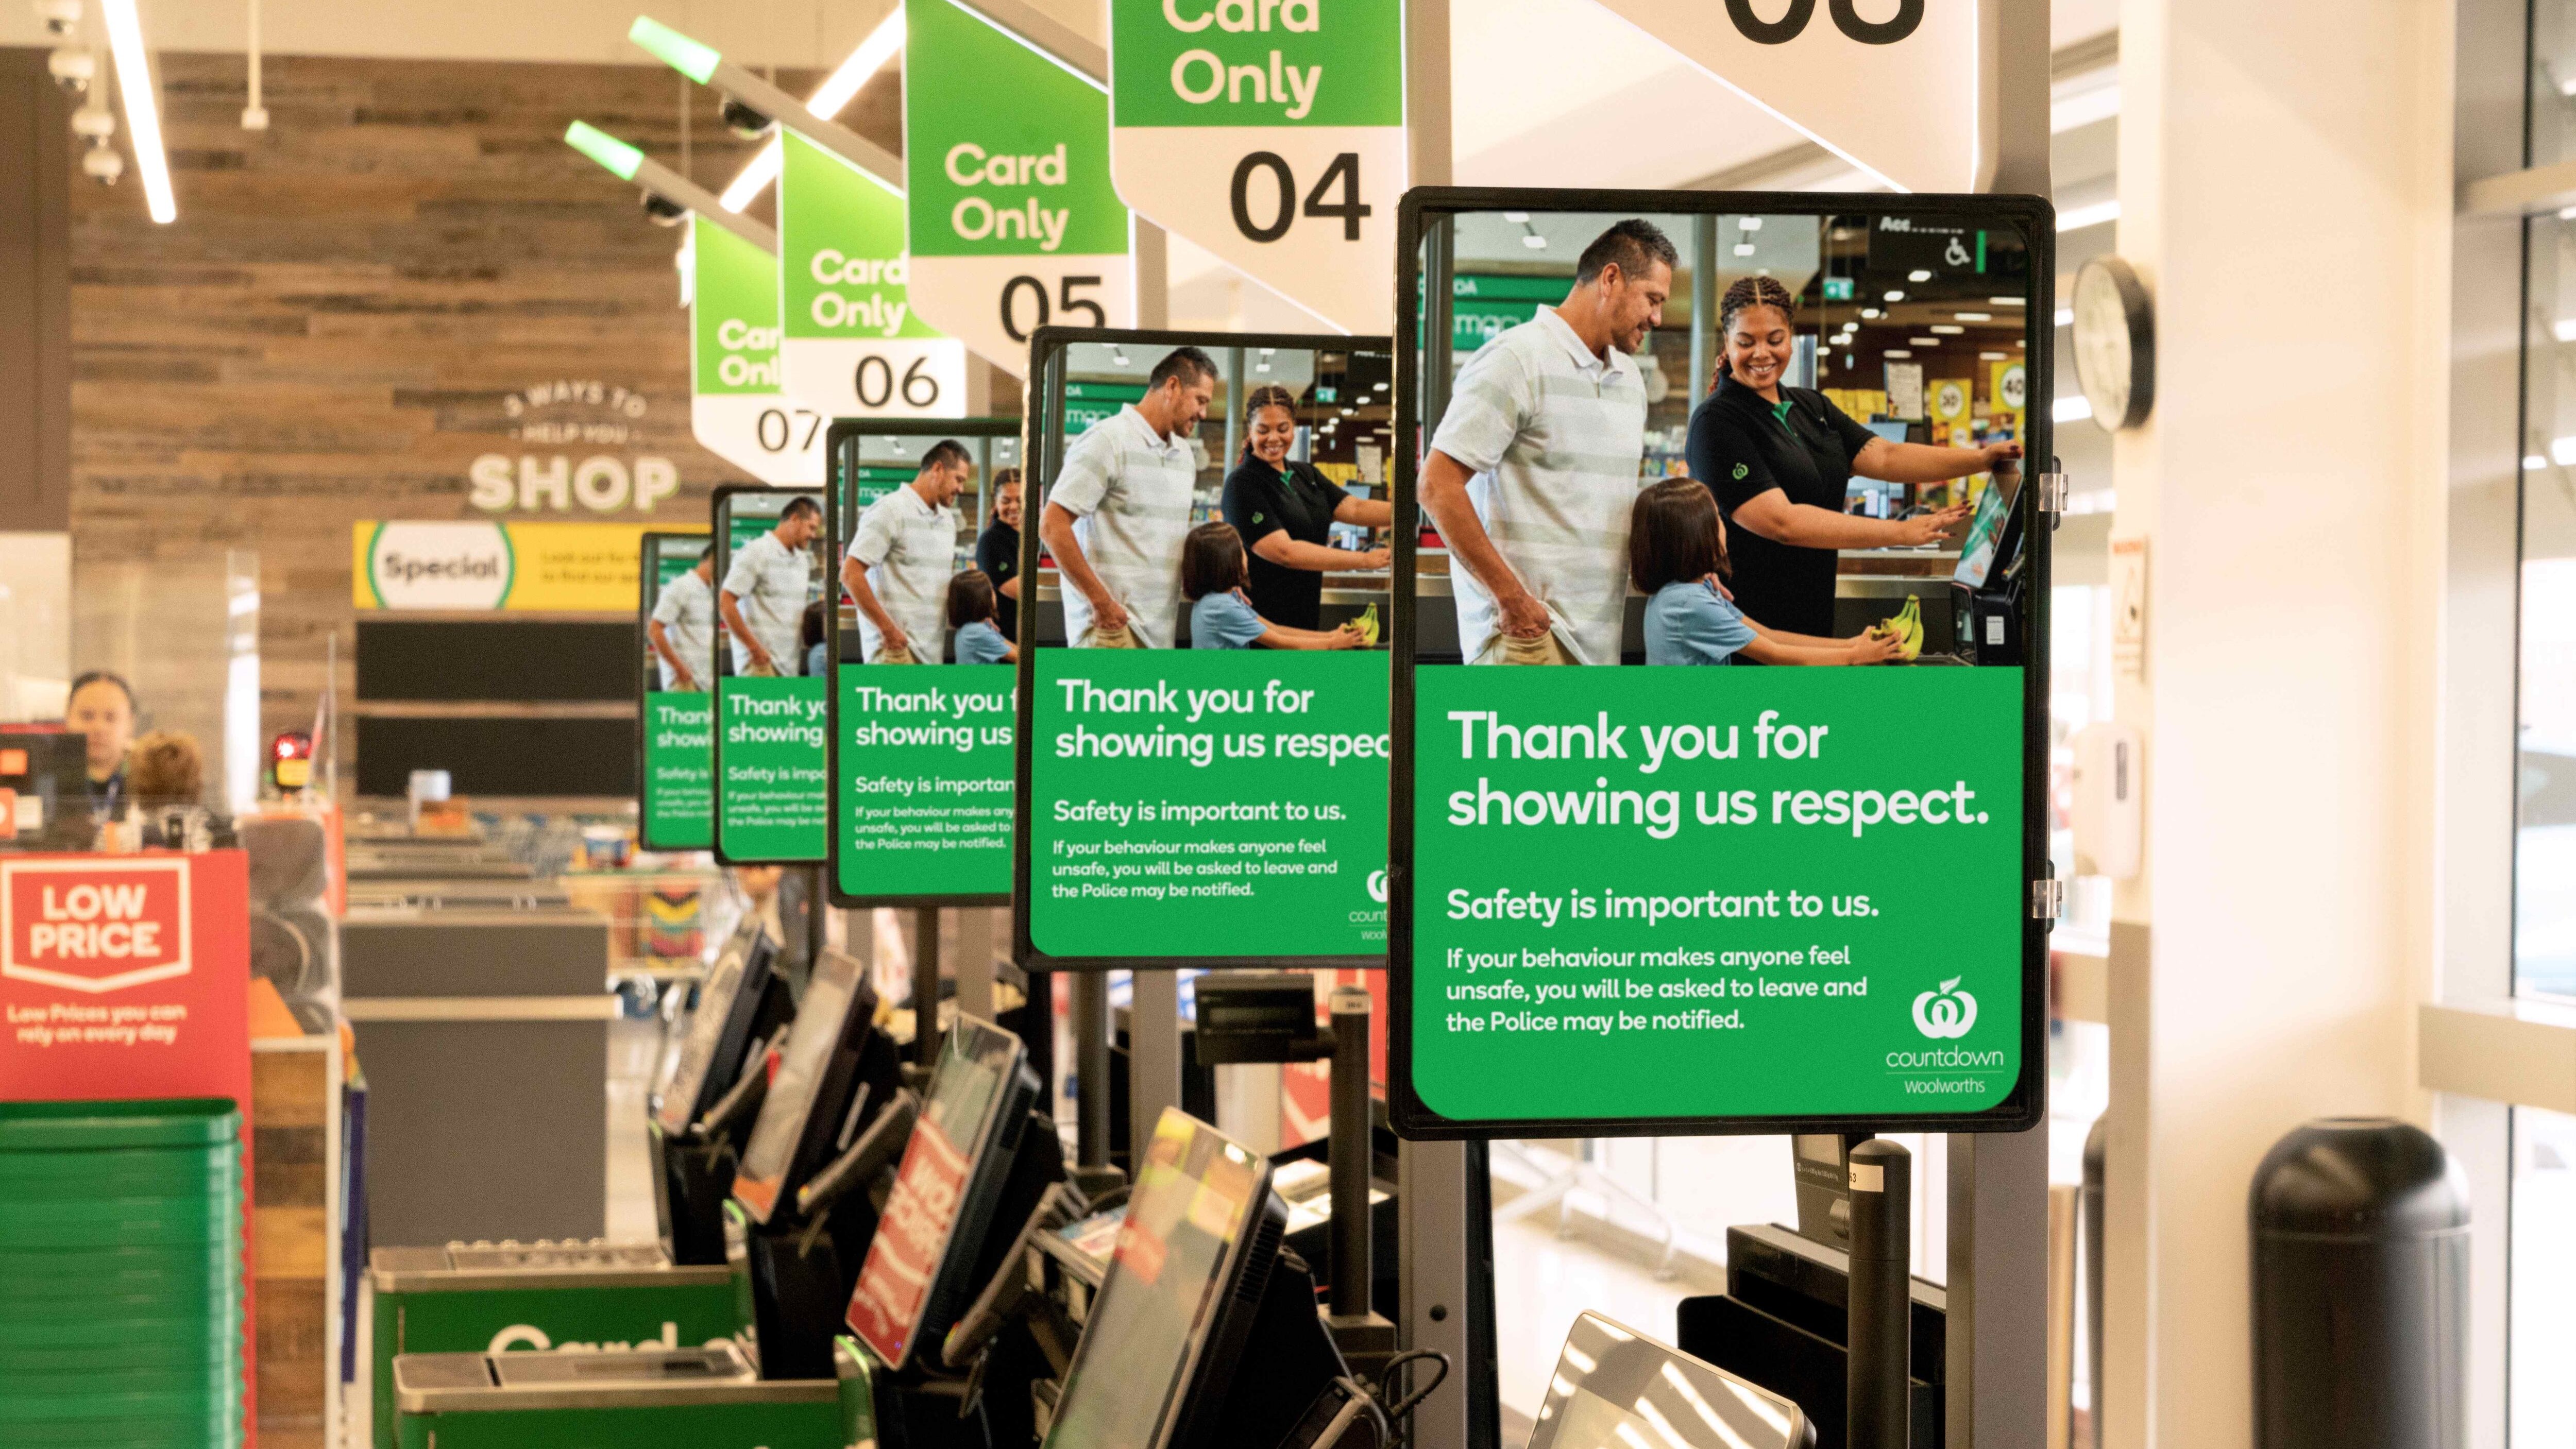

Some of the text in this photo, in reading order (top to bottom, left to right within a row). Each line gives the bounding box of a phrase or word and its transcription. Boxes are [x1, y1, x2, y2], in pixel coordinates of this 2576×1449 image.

[1162, 0, 1319, 33] Card
[1171, 49, 1322, 120] Only
[945, 143, 1067, 186] Card
[1230, 151, 1371, 244] 04
[952, 197, 1069, 251] Only
[810, 248, 909, 285] Card
[811, 292, 907, 337] Only
[1001, 275, 1106, 343] 05
[718, 318, 783, 351] Car
[718, 354, 778, 387] Onl
[855, 355, 939, 408] 06
[757, 409, 821, 452] 07
[470, 454, 679, 512] SHOP
[383, 551, 499, 585] Special
[656, 706, 713, 725] Than
[728, 693, 802, 716] Thank
[855, 686, 947, 712] Thank
[952, 693, 1004, 720] you
[1056, 678, 1179, 713] Thank
[1185, 689, 1254, 723] you
[1263, 679, 1315, 714] for
[656, 729, 713, 748] show
[728, 721, 824, 748] showing
[856, 720, 1013, 753] showing us
[1055, 724, 1390, 768] showing us respec
[1447, 709, 1828, 774] Thank you for
[727, 766, 776, 784] Safety
[777, 766, 790, 780] is
[855, 775, 1015, 797] Safety is importan
[865, 809, 891, 821] your
[892, 806, 952, 817] behaviour
[952, 806, 991, 817] makes
[1054, 799, 1346, 827] Safety is important to us.
[1448, 776, 1989, 840] showing us respect.
[855, 839, 876, 850] the
[877, 838, 912, 850] Police
[913, 840, 941, 852] may
[941, 838, 958, 849] be
[900, 824, 922, 836] you
[923, 821, 944, 833] will
[945, 822, 961, 833] be
[961, 821, 997, 833] asked
[997, 822, 1011, 832] to
[1053, 838, 1327, 859] If your behaviour makes anyone feel
[1052, 860, 1338, 879] unsafe, you will be asked to leave and
[43, 884, 147, 921] LOW
[1051, 881, 1255, 901] the Police may be notified.
[1348, 909, 1387, 923] count
[1447, 888, 1879, 928] Safety is important to us.
[30, 921, 162, 959] PRICE
[1447, 945, 1851, 974] If your behaviour makes anyone feel
[1446, 976, 1868, 1005] unsafe, you will be asked to leave and
[7, 1003, 49, 1024] Low
[110, 1005, 148, 1026] you
[148, 1004, 188, 1022] can
[1446, 1009, 1745, 1036] the Police may be notified.
[54, 1027, 83, 1043] on
[138, 1024, 178, 1046] day
[1886, 1045, 2004, 1068] countdown
